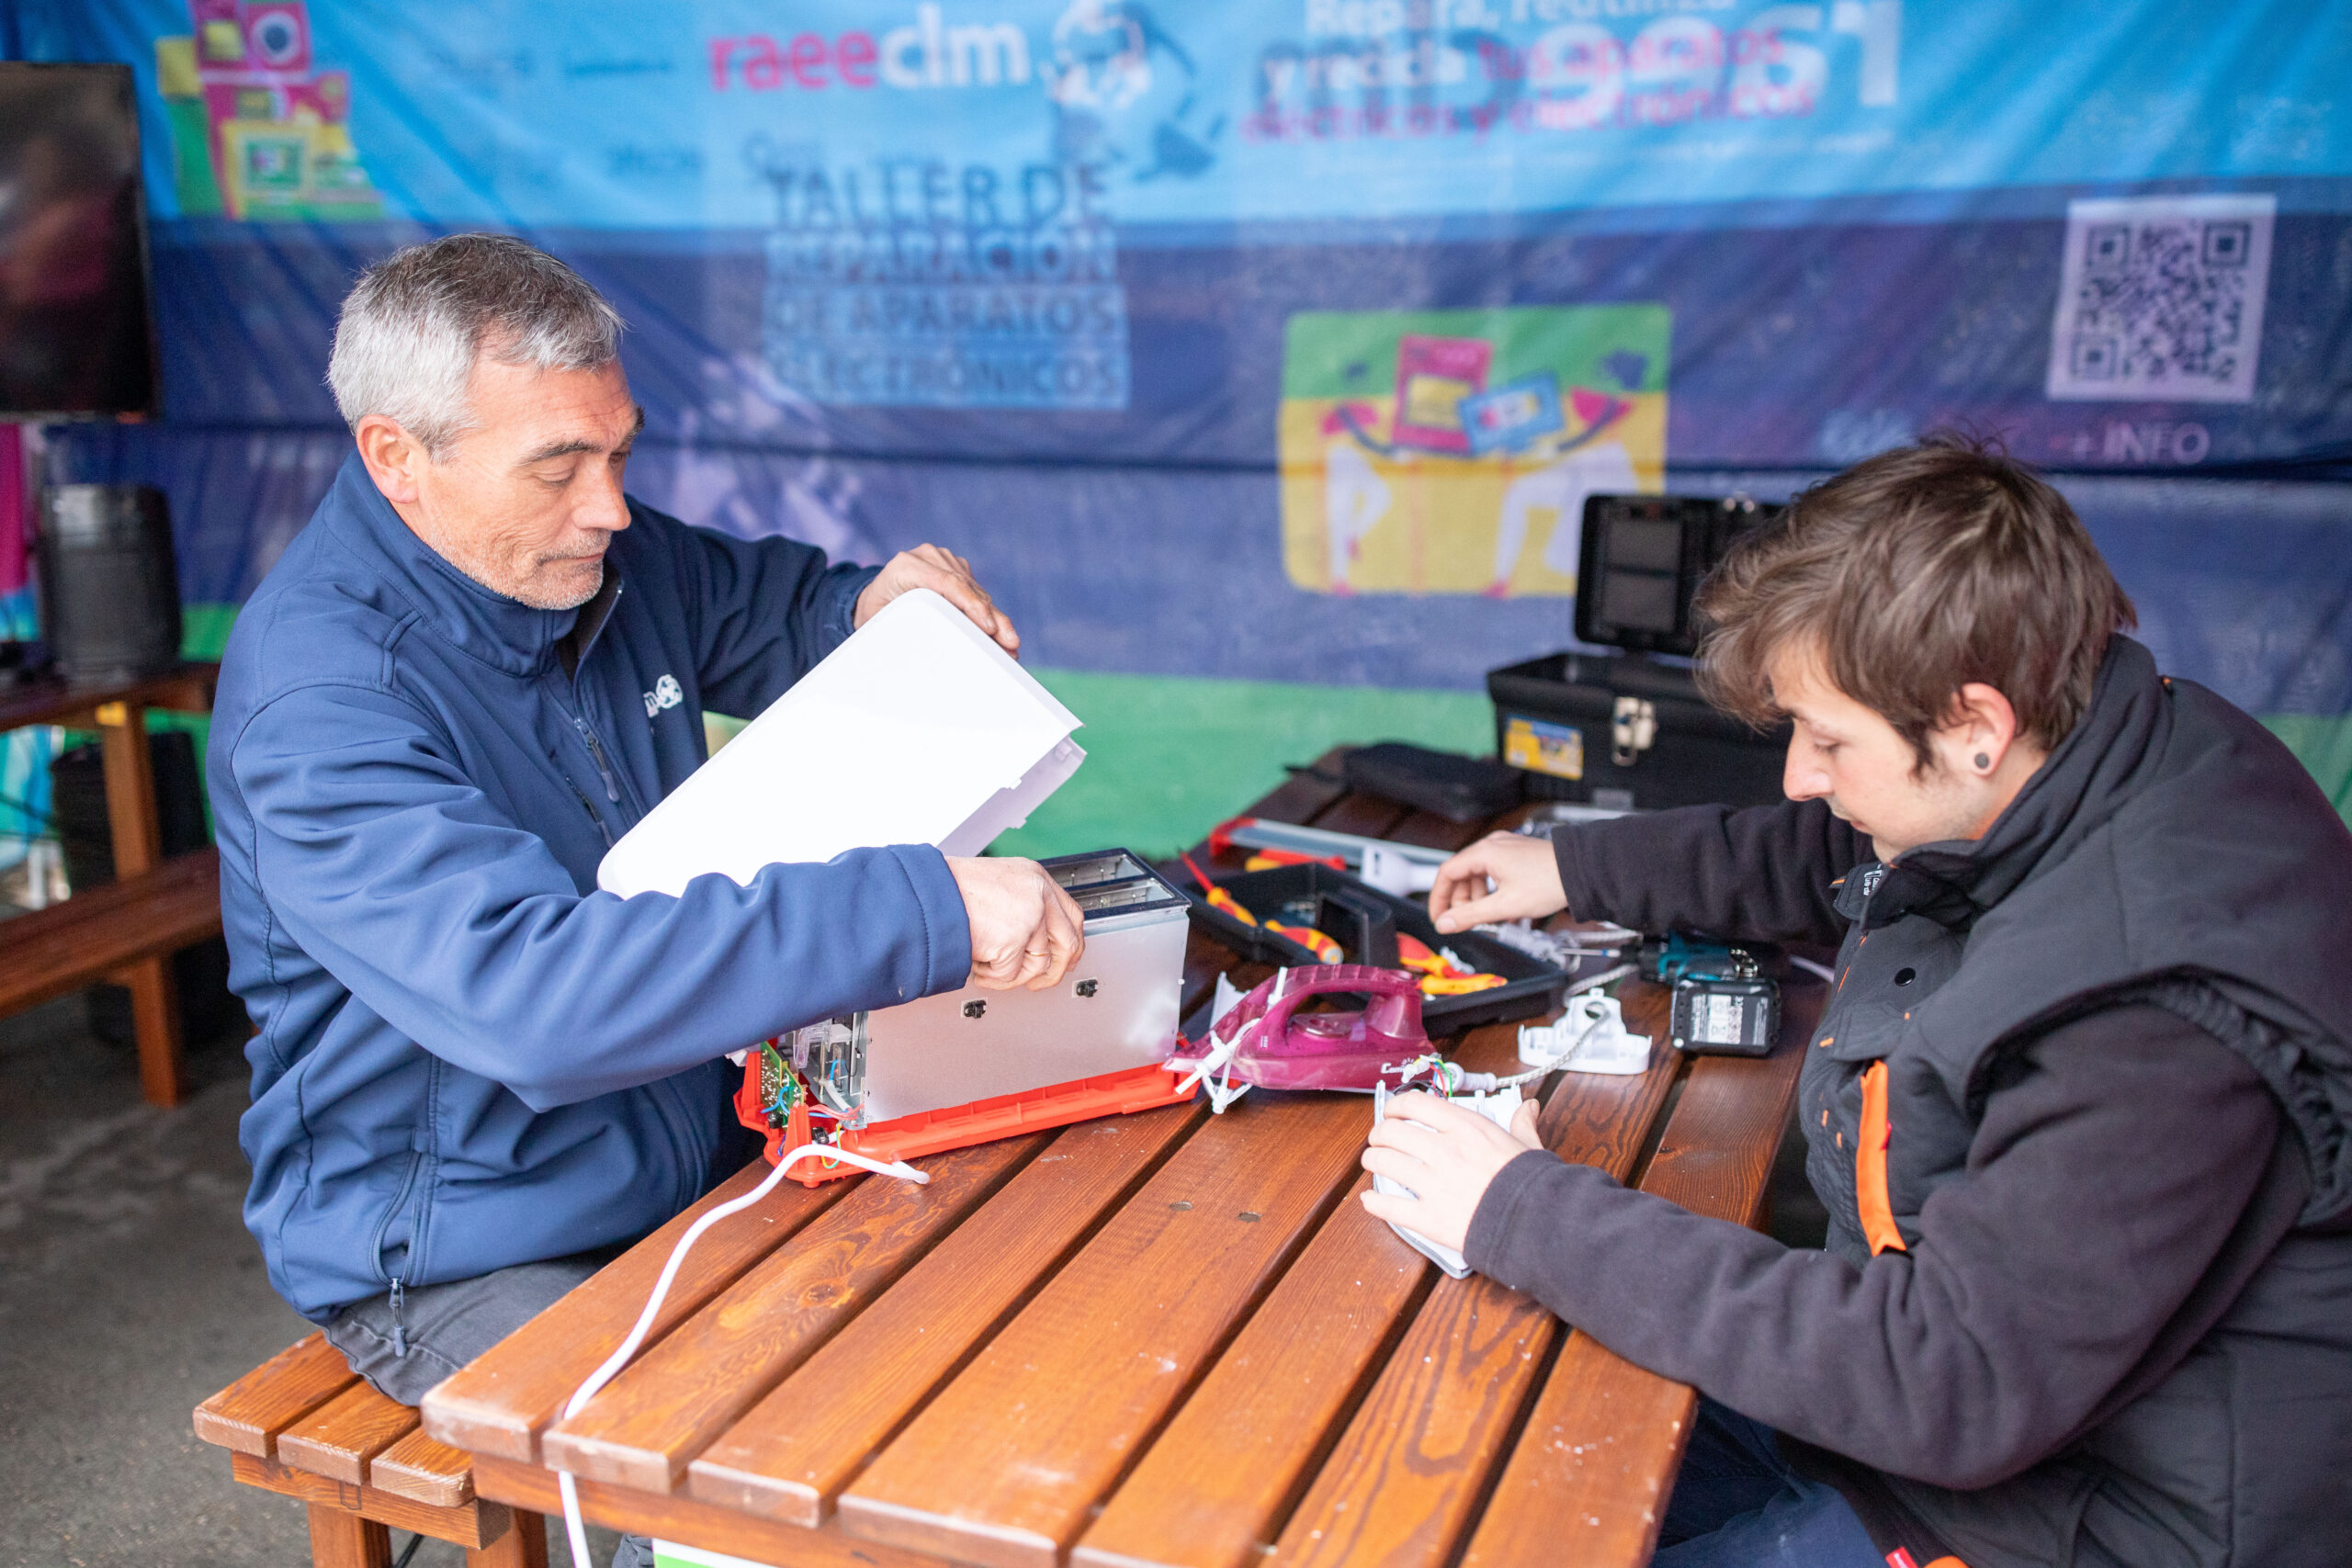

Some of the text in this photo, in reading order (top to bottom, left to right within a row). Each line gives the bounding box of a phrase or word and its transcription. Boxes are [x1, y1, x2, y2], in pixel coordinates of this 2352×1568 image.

[766, 162, 1105, 225] TALLER DE
[2103, 422, 2210, 465] INFO
